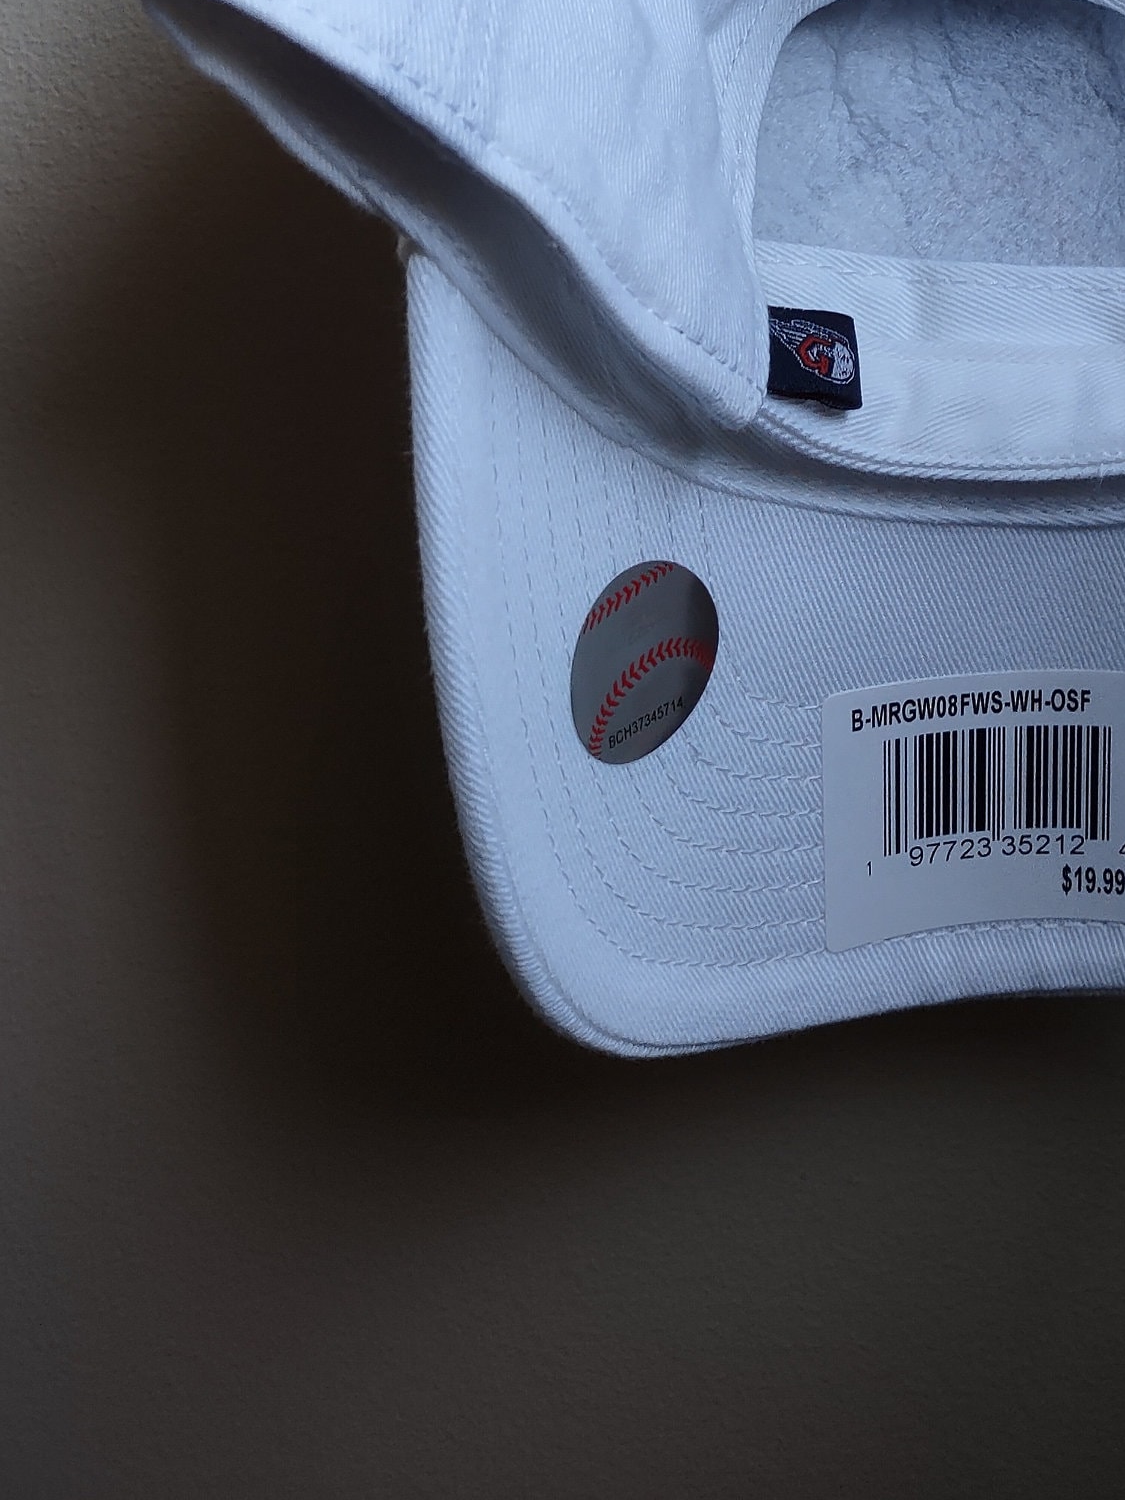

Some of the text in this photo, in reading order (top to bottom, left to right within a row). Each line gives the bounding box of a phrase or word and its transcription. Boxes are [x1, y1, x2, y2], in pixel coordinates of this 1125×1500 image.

[608, 696, 684, 749] BCH37345714
[851, 688, 1091, 732] B-MRGW08FWS-WH-OSF
[866, 860, 873, 877] 1
[909, 837, 992, 867] 97723
[1001, 834, 1085, 856] 35212
[1061, 864, 1125, 896] $19.99
